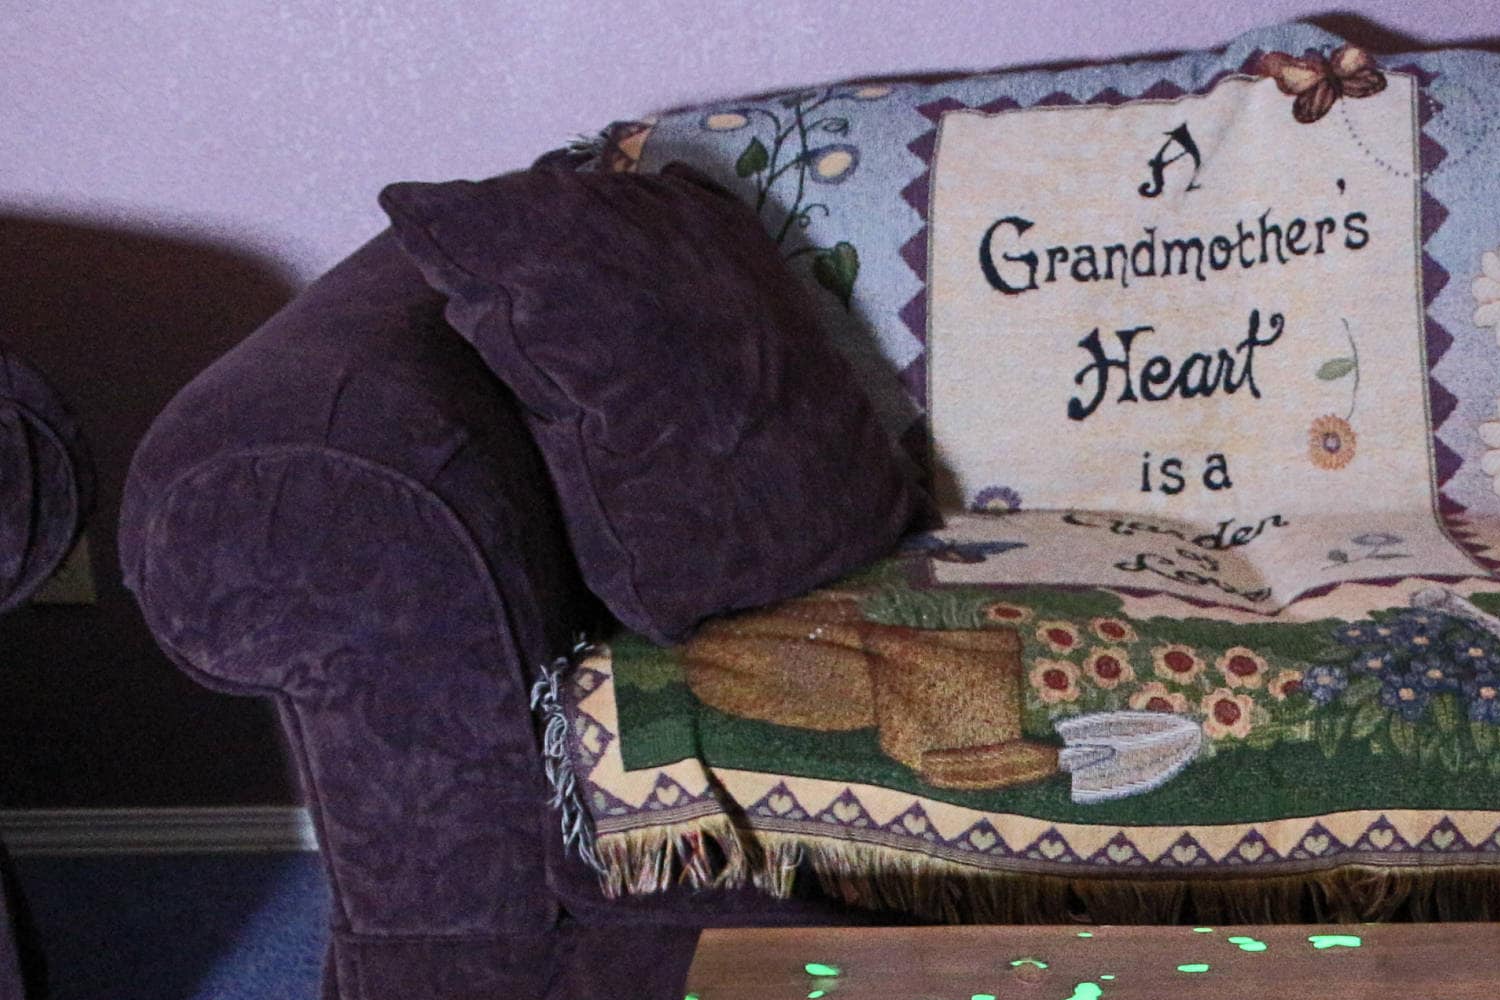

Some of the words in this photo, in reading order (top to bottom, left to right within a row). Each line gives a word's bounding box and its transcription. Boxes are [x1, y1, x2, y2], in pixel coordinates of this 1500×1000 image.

[1138, 122, 1202, 198] A
[979, 178, 1370, 295] Grandmother's
[1067, 308, 1285, 421] Heart
[1141, 452, 1186, 494] is
[1203, 453, 1232, 491] a
